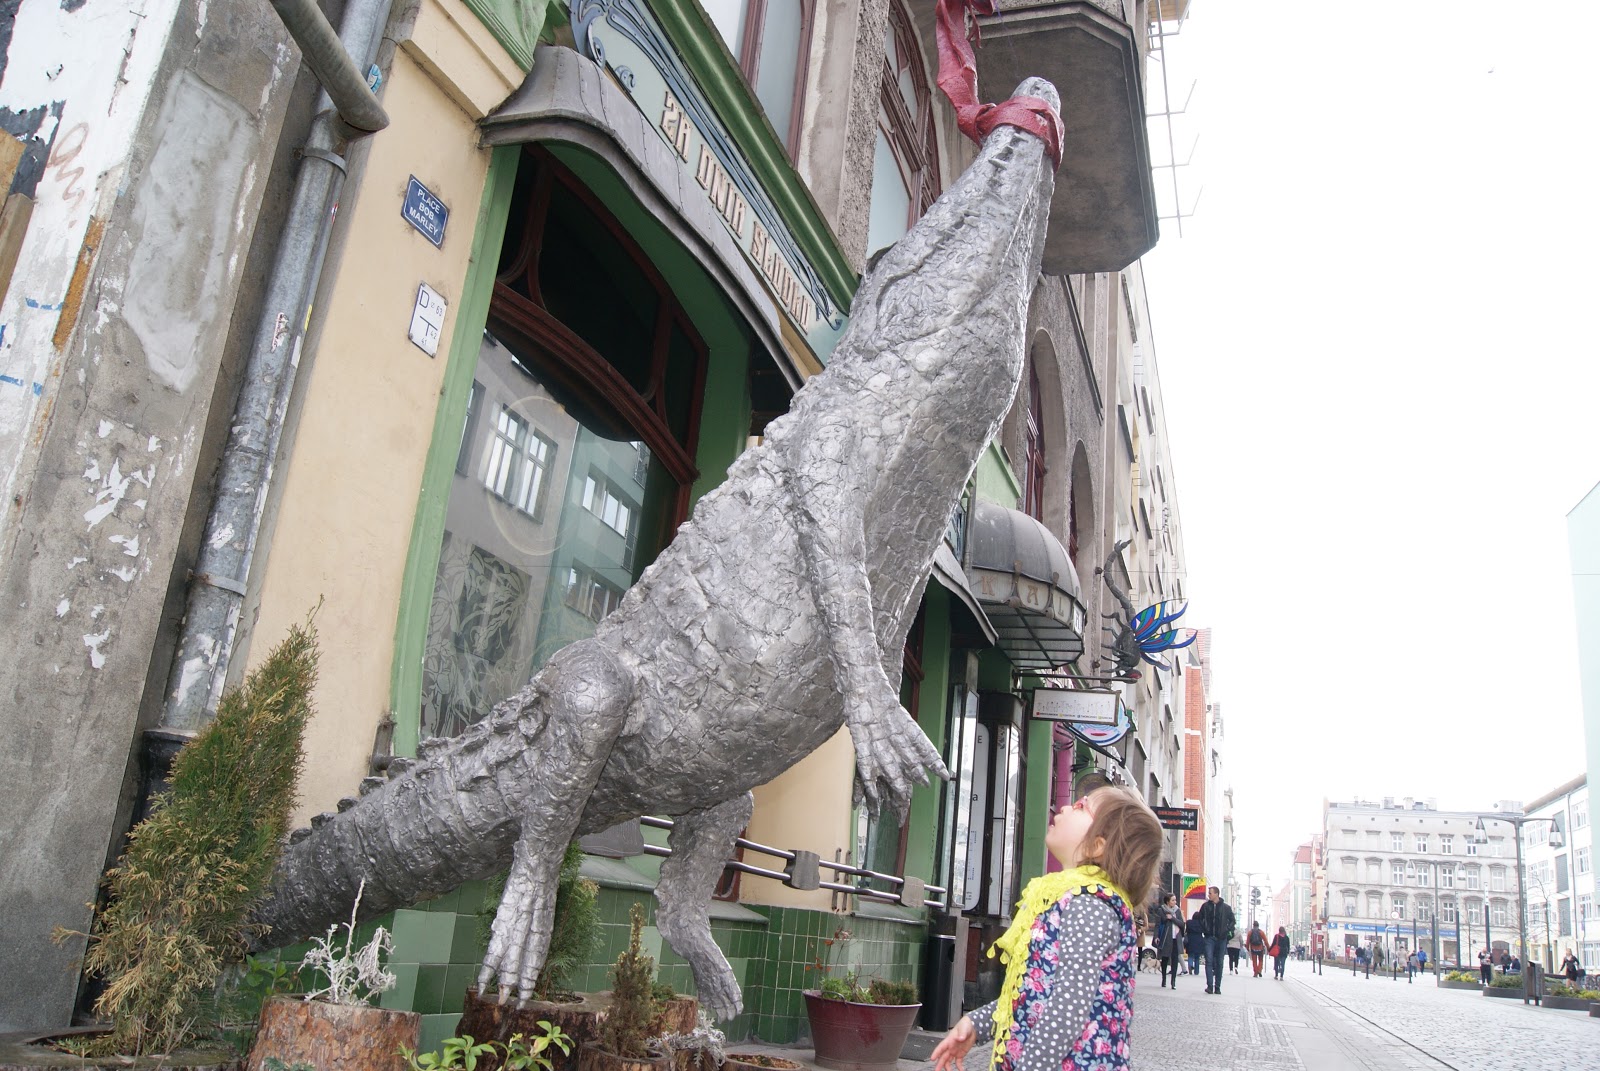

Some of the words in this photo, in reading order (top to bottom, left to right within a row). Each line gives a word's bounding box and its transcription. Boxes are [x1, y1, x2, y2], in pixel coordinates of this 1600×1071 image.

[417, 188, 441, 214] PLACE
[418, 202, 435, 221] BOB
[409, 206, 439, 236] MARLEY
[419, 289, 430, 309] D
